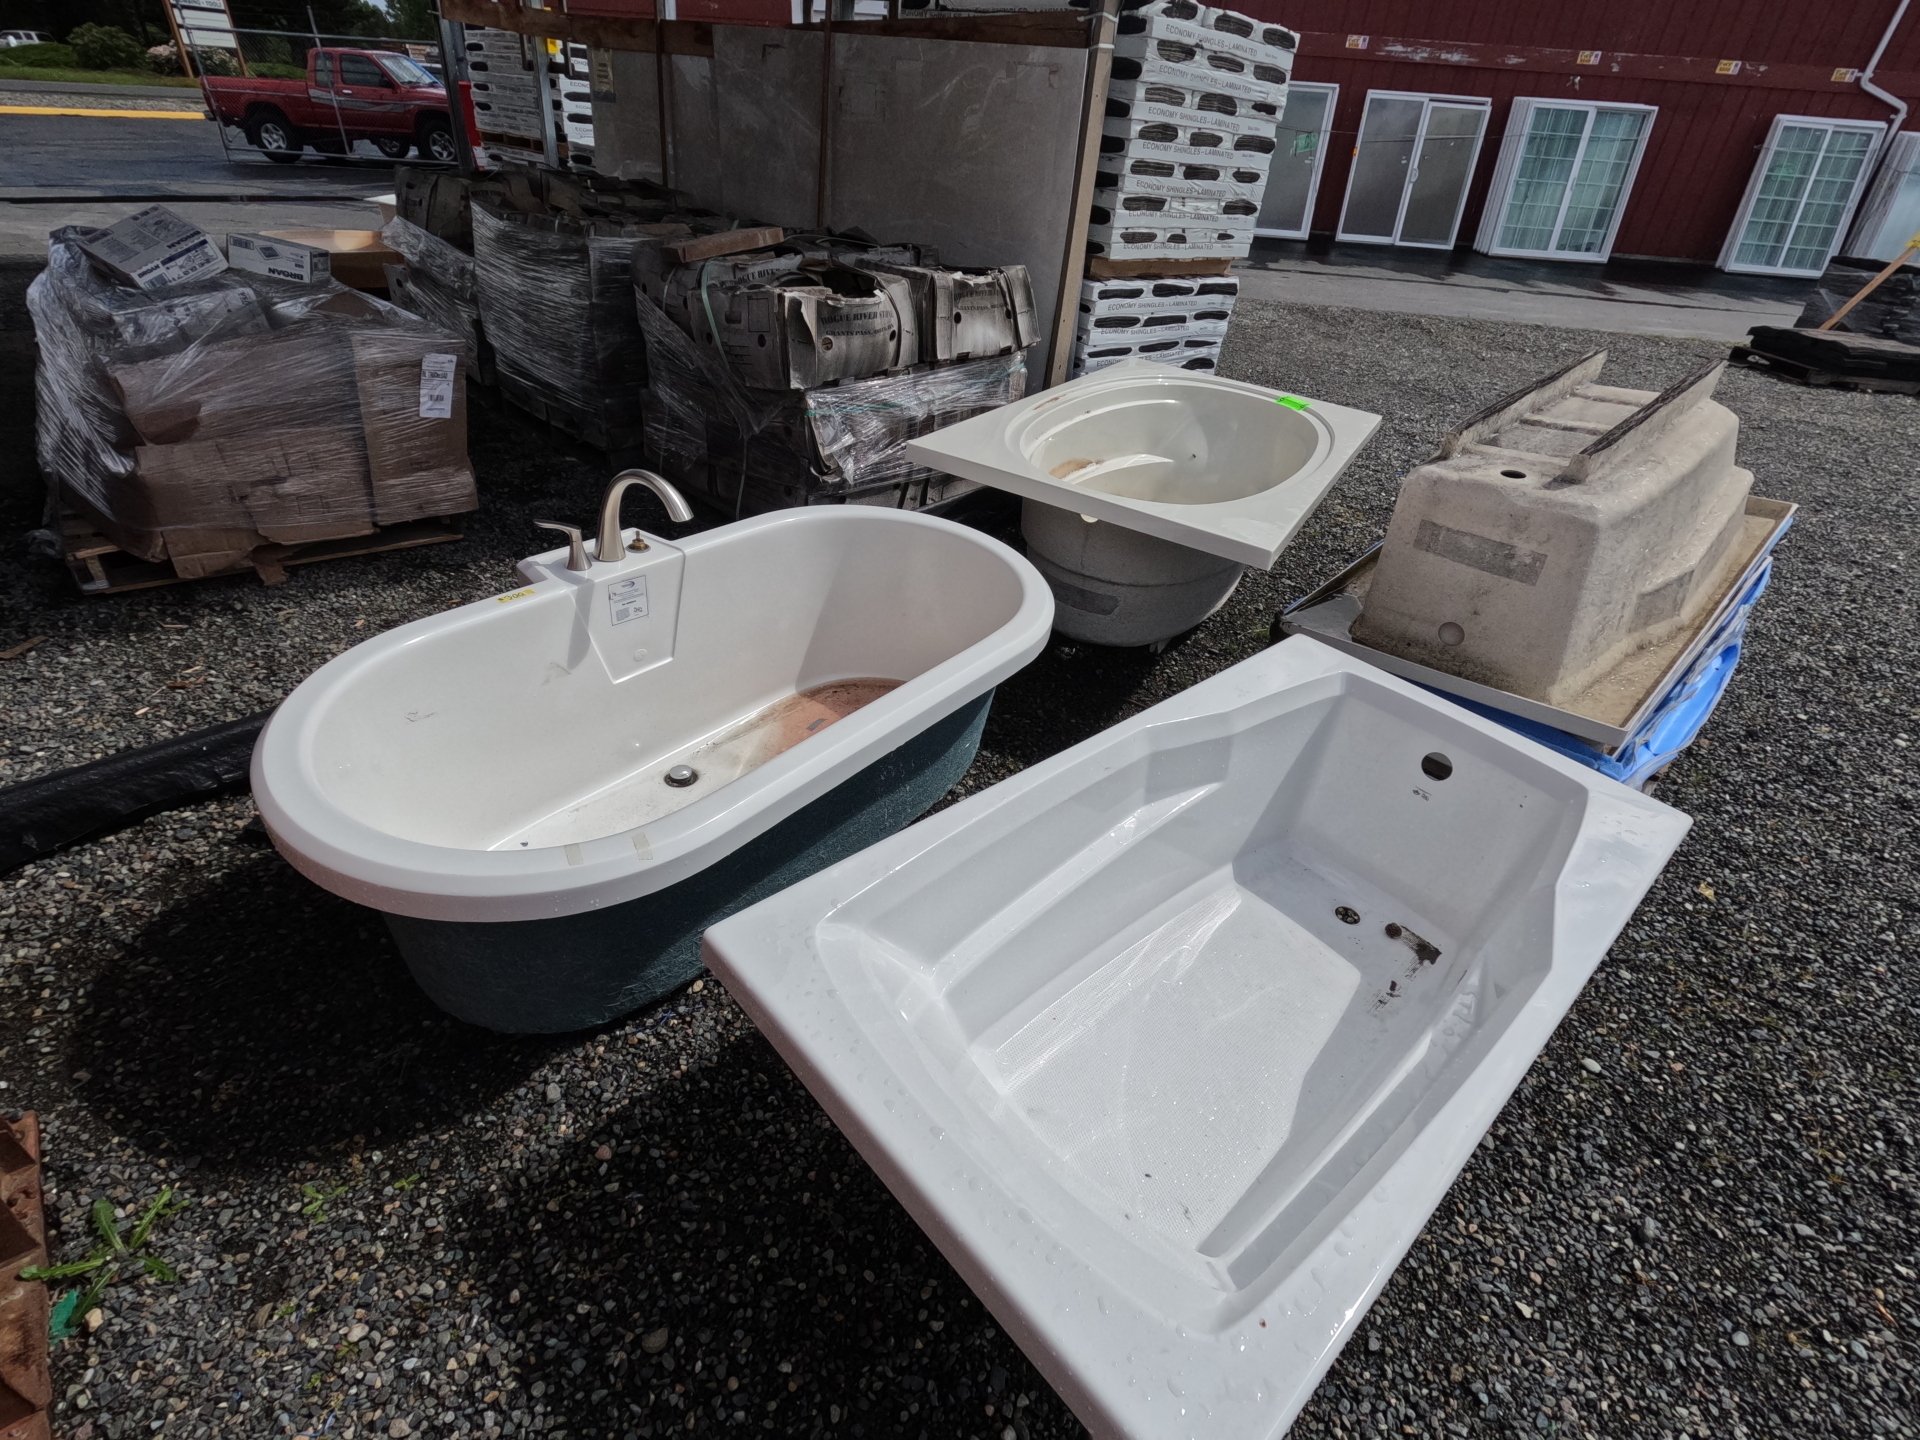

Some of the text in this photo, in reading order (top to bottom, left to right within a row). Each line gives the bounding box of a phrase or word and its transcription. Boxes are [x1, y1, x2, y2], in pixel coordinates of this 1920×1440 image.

[1165, 24, 1196, 39] ECONOMY
[1159, 64, 1189, 80] ECONOMY
[1147, 106, 1178, 119] ECONOMY
[1142, 141, 1173, 153] ECONOMY
[1136, 179, 1166, 192] ECONOMY
[268, 266, 304, 281] BROAN
[1107, 301, 1136, 311] ECONOMY
[1100, 326, 1129, 336] ECONOMY
